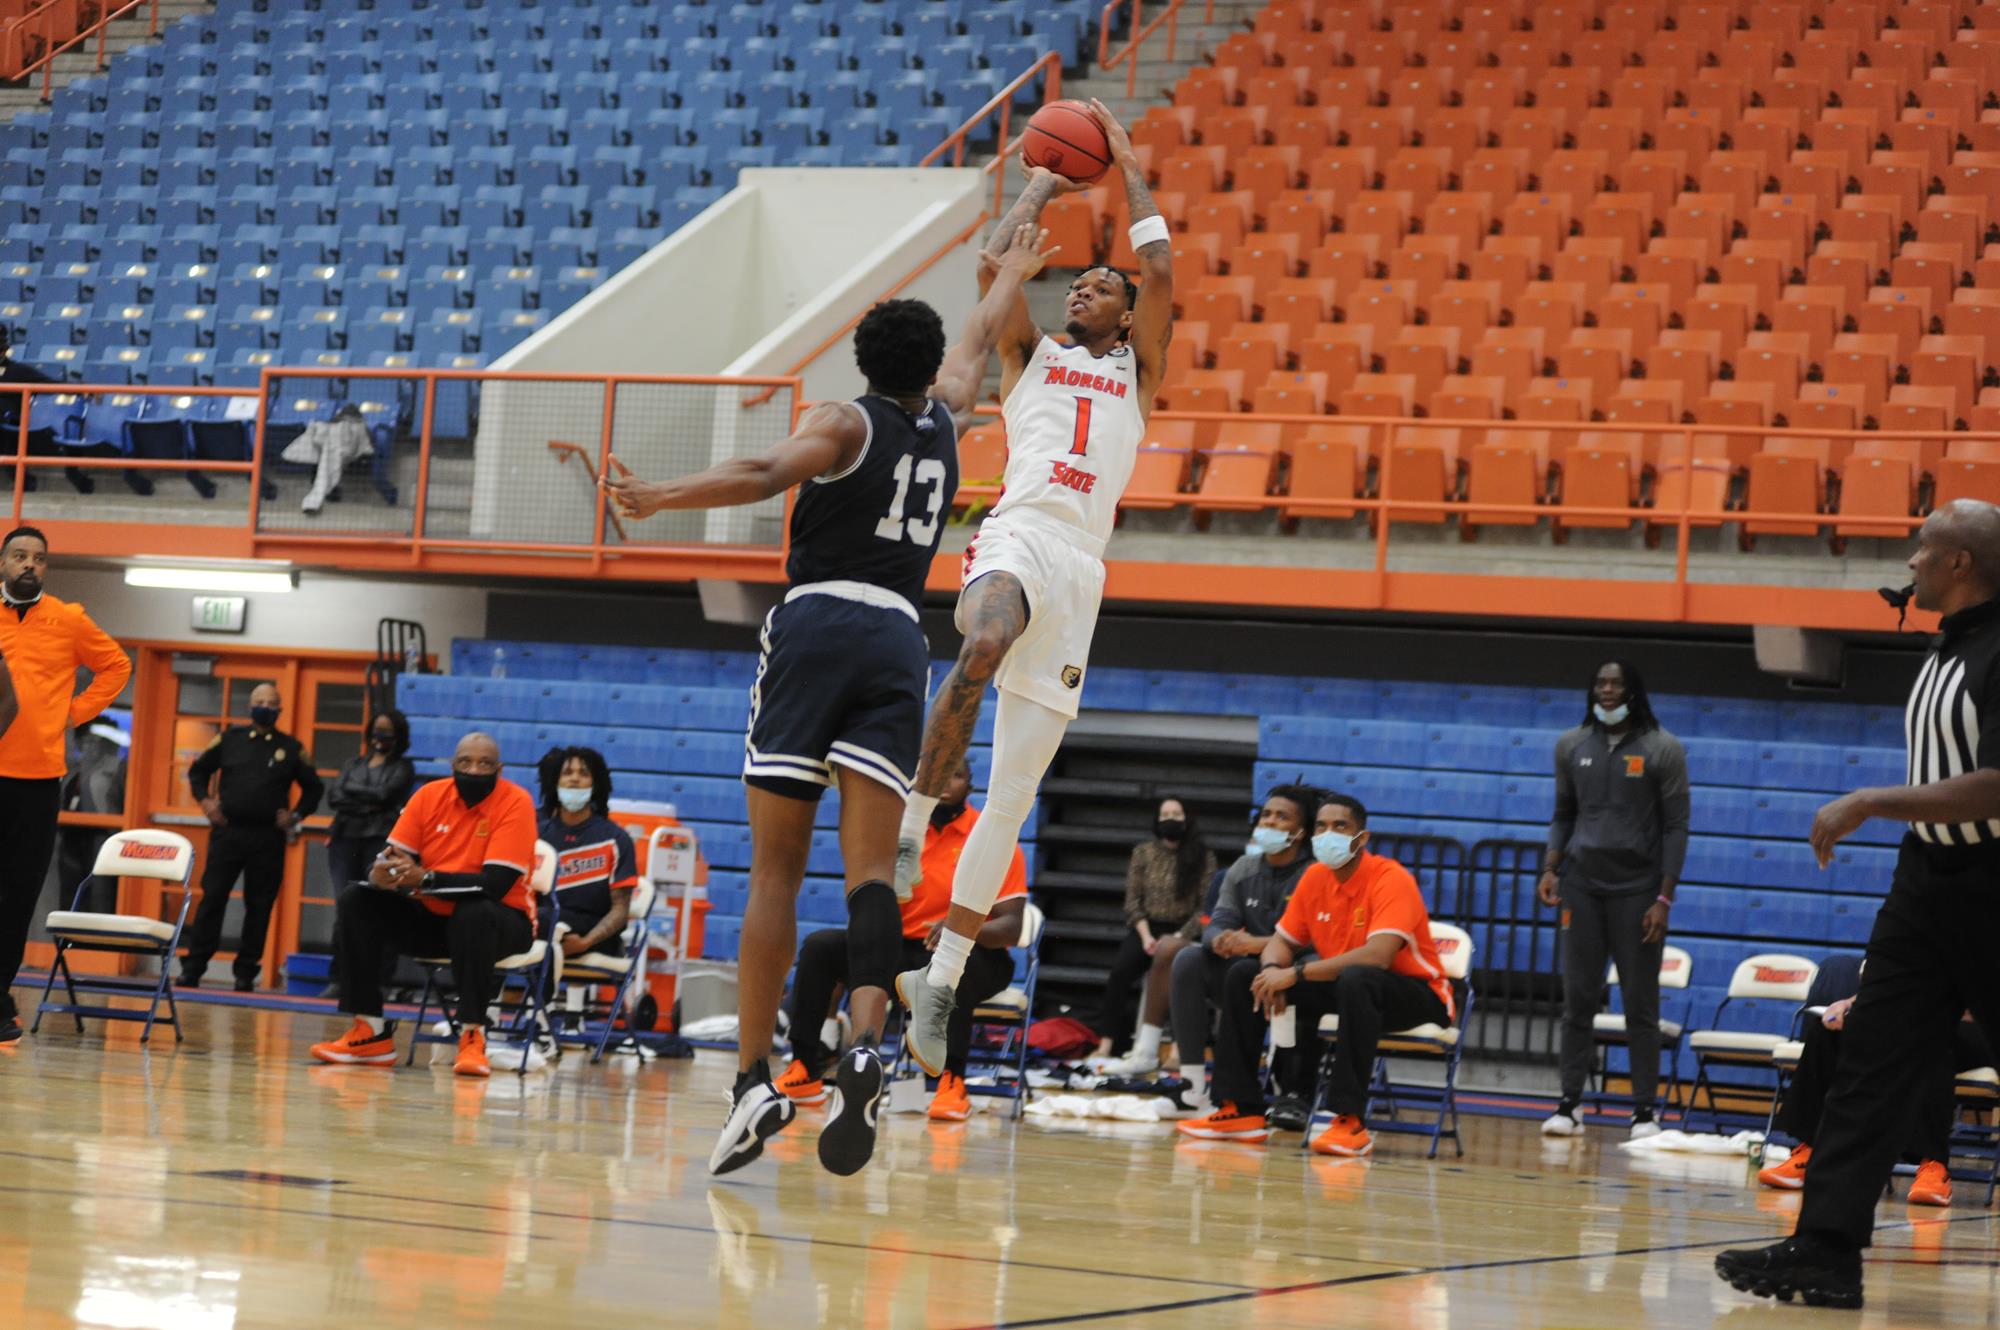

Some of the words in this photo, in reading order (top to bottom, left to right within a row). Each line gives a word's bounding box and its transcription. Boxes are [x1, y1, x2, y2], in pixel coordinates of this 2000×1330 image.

[1043, 366, 1127, 398] MORGAN
[1069, 396, 1092, 456] 1
[1048, 460, 1096, 494] STATE
[874, 453, 946, 547] 13
[202, 600, 231, 625] EXIT
